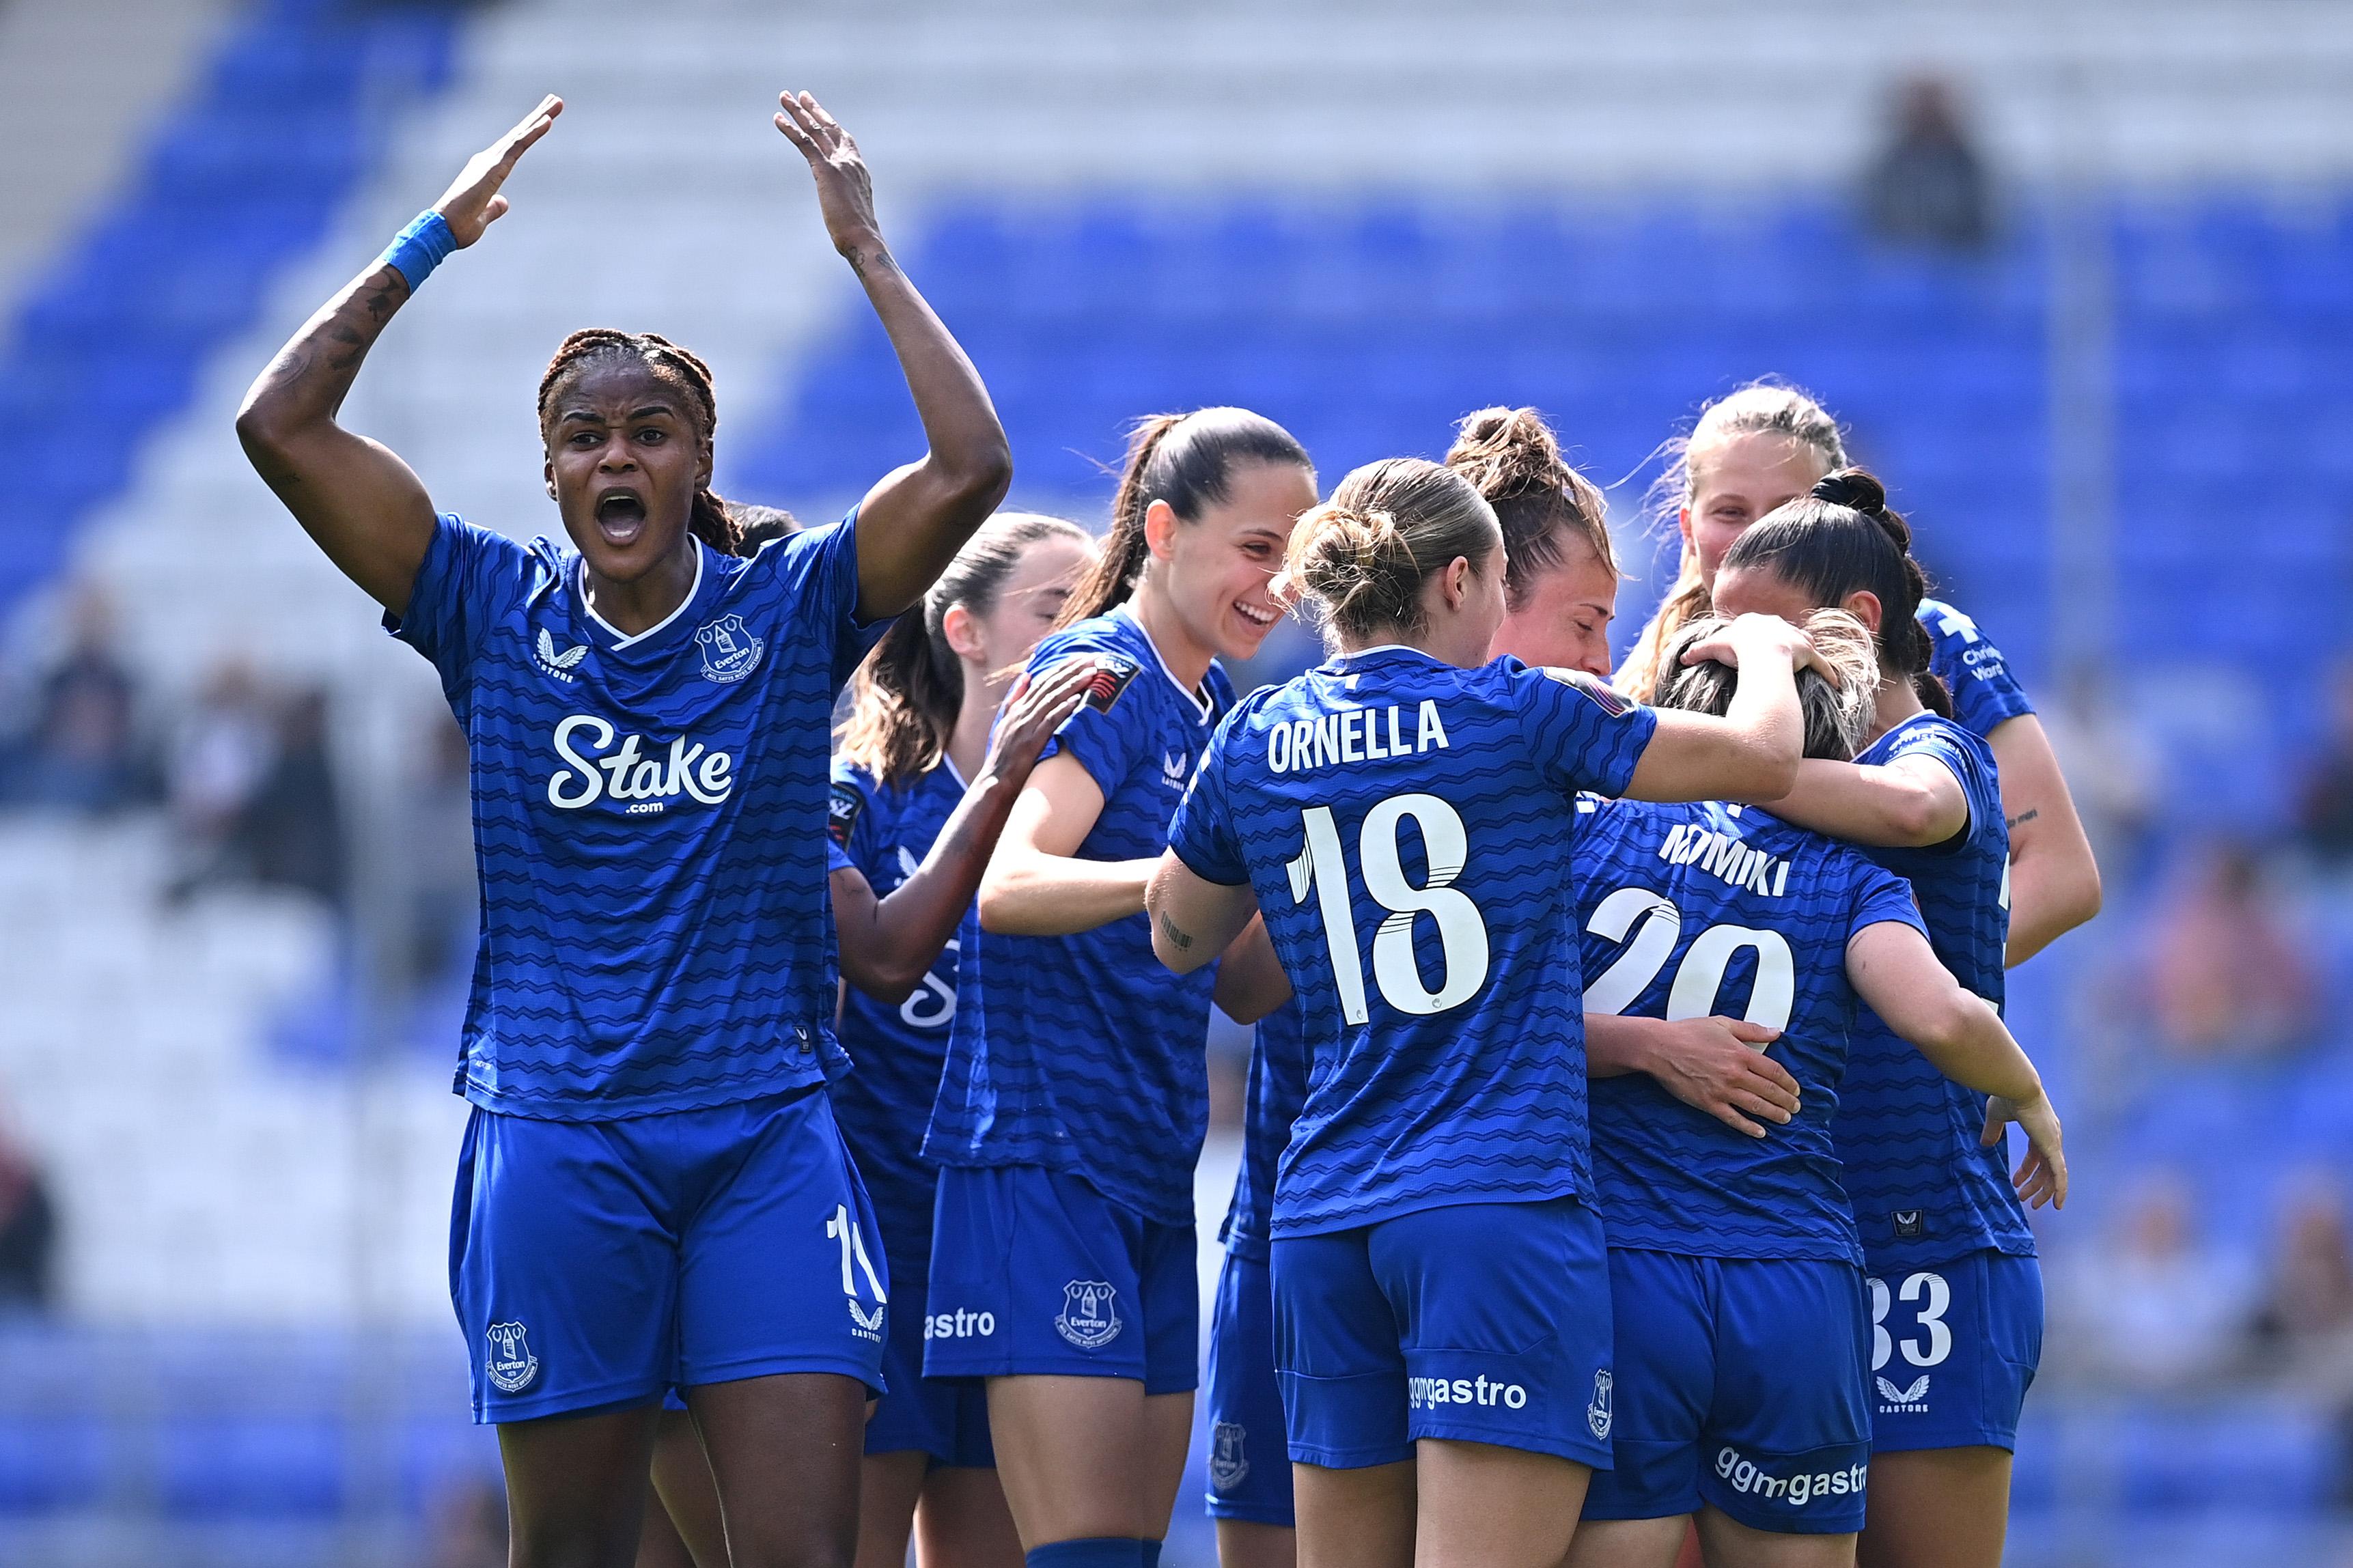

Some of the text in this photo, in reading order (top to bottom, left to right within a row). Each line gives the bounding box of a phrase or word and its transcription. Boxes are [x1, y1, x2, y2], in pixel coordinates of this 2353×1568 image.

[714, 647, 750, 669] Everton
[1971, 660, 2004, 682] Ward
[1268, 700, 1449, 773] ORNELLA
[548, 715, 732, 809] Stake
[625, 800, 664, 813] .com
[1285, 793, 1489, 1026] 18
[1583, 888, 1794, 1054] 20
[826, 1204, 887, 1304] 11
[923, 1306, 995, 1341] astro
[1070, 1316, 1106, 1328] Everton
[497, 1360, 525, 1371] Everton
[1408, 1374, 1527, 1410] ggmgastro
[1879, 1404, 1928, 1413] CASTORE
[1715, 1446, 1867, 1505] ggmgastr
